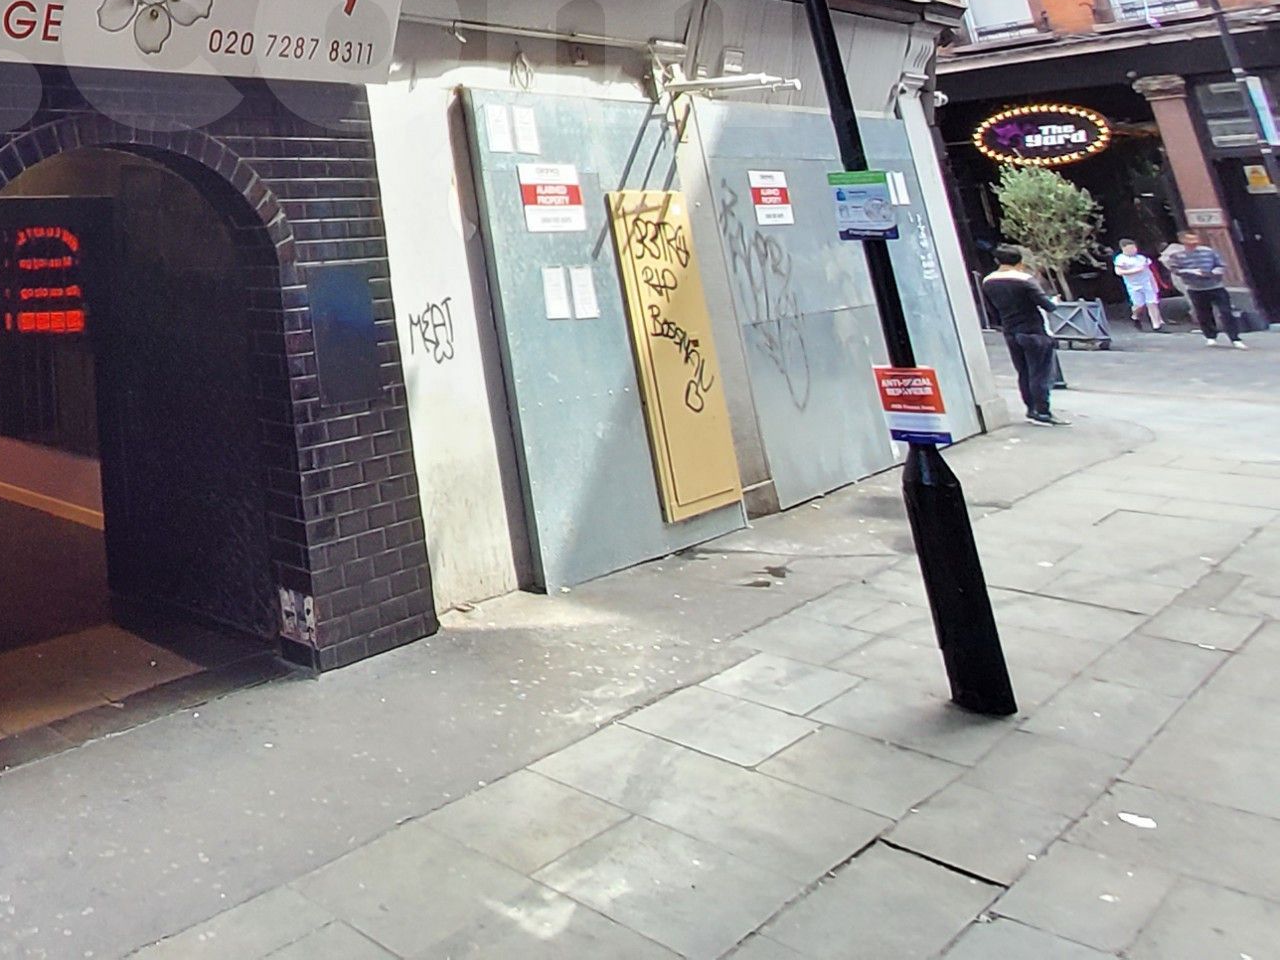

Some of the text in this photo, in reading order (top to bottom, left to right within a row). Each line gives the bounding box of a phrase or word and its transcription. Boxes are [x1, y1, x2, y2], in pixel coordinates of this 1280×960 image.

[208, 28, 373, 65] 020 7287 8311
[1038, 124, 1076, 135] The
